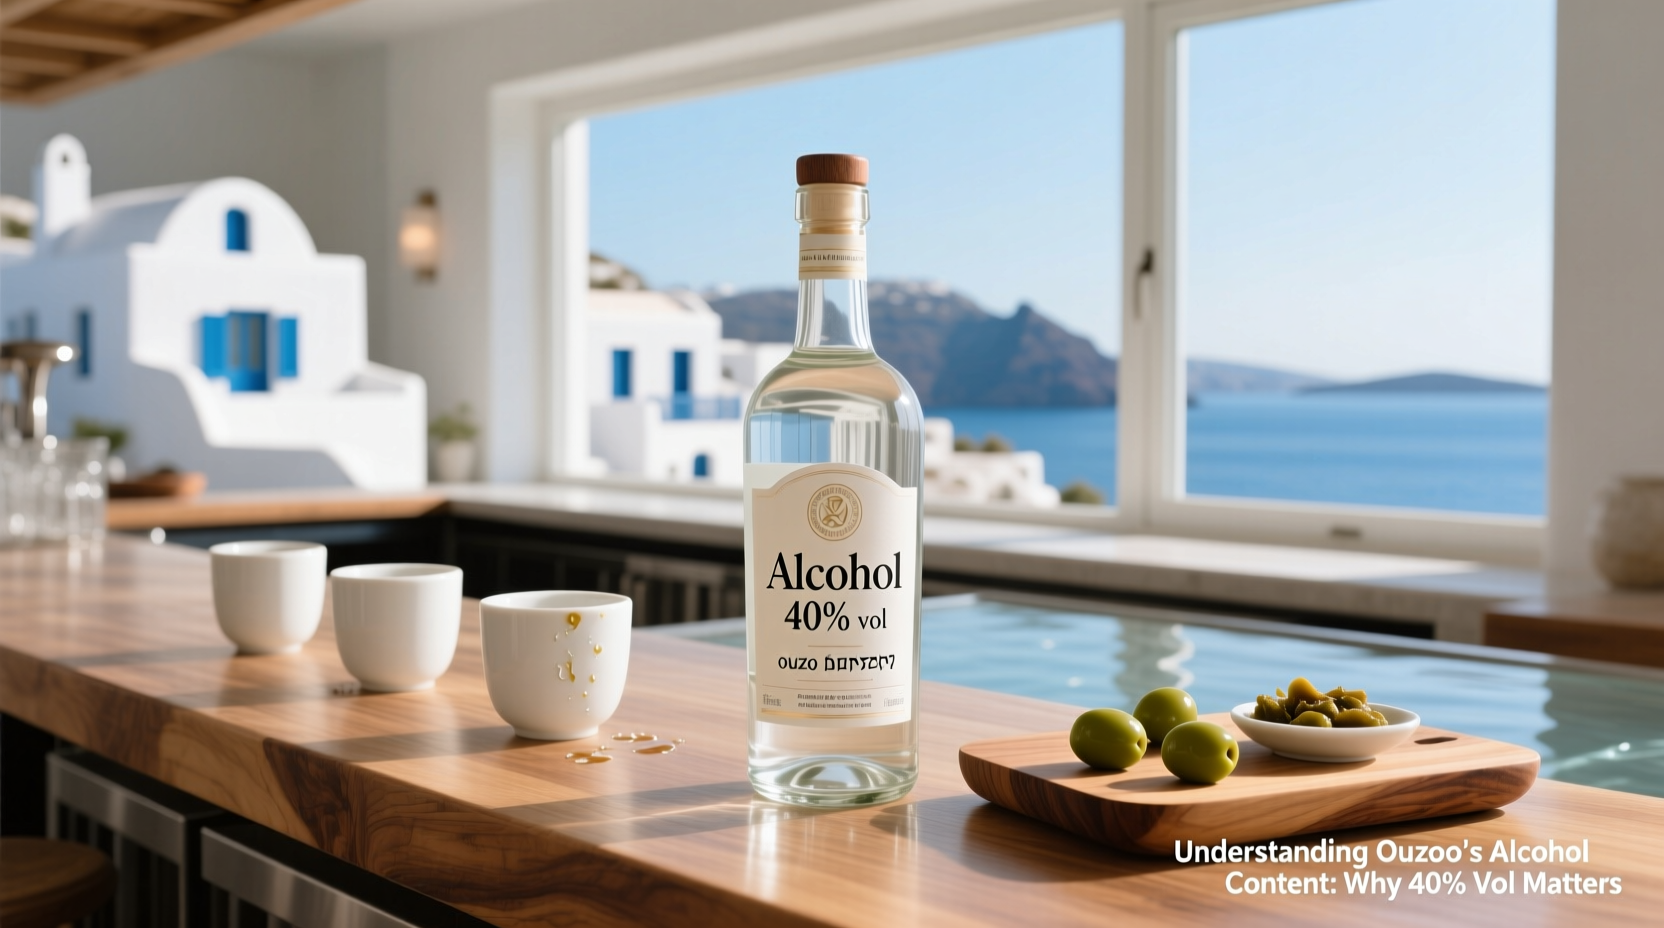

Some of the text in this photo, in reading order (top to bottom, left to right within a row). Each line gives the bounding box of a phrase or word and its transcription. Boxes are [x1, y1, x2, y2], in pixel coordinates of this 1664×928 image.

[766, 551, 902, 591] Alcohol
[784, 600, 887, 632] 40% vol
[778, 656, 818, 671] ouzo
